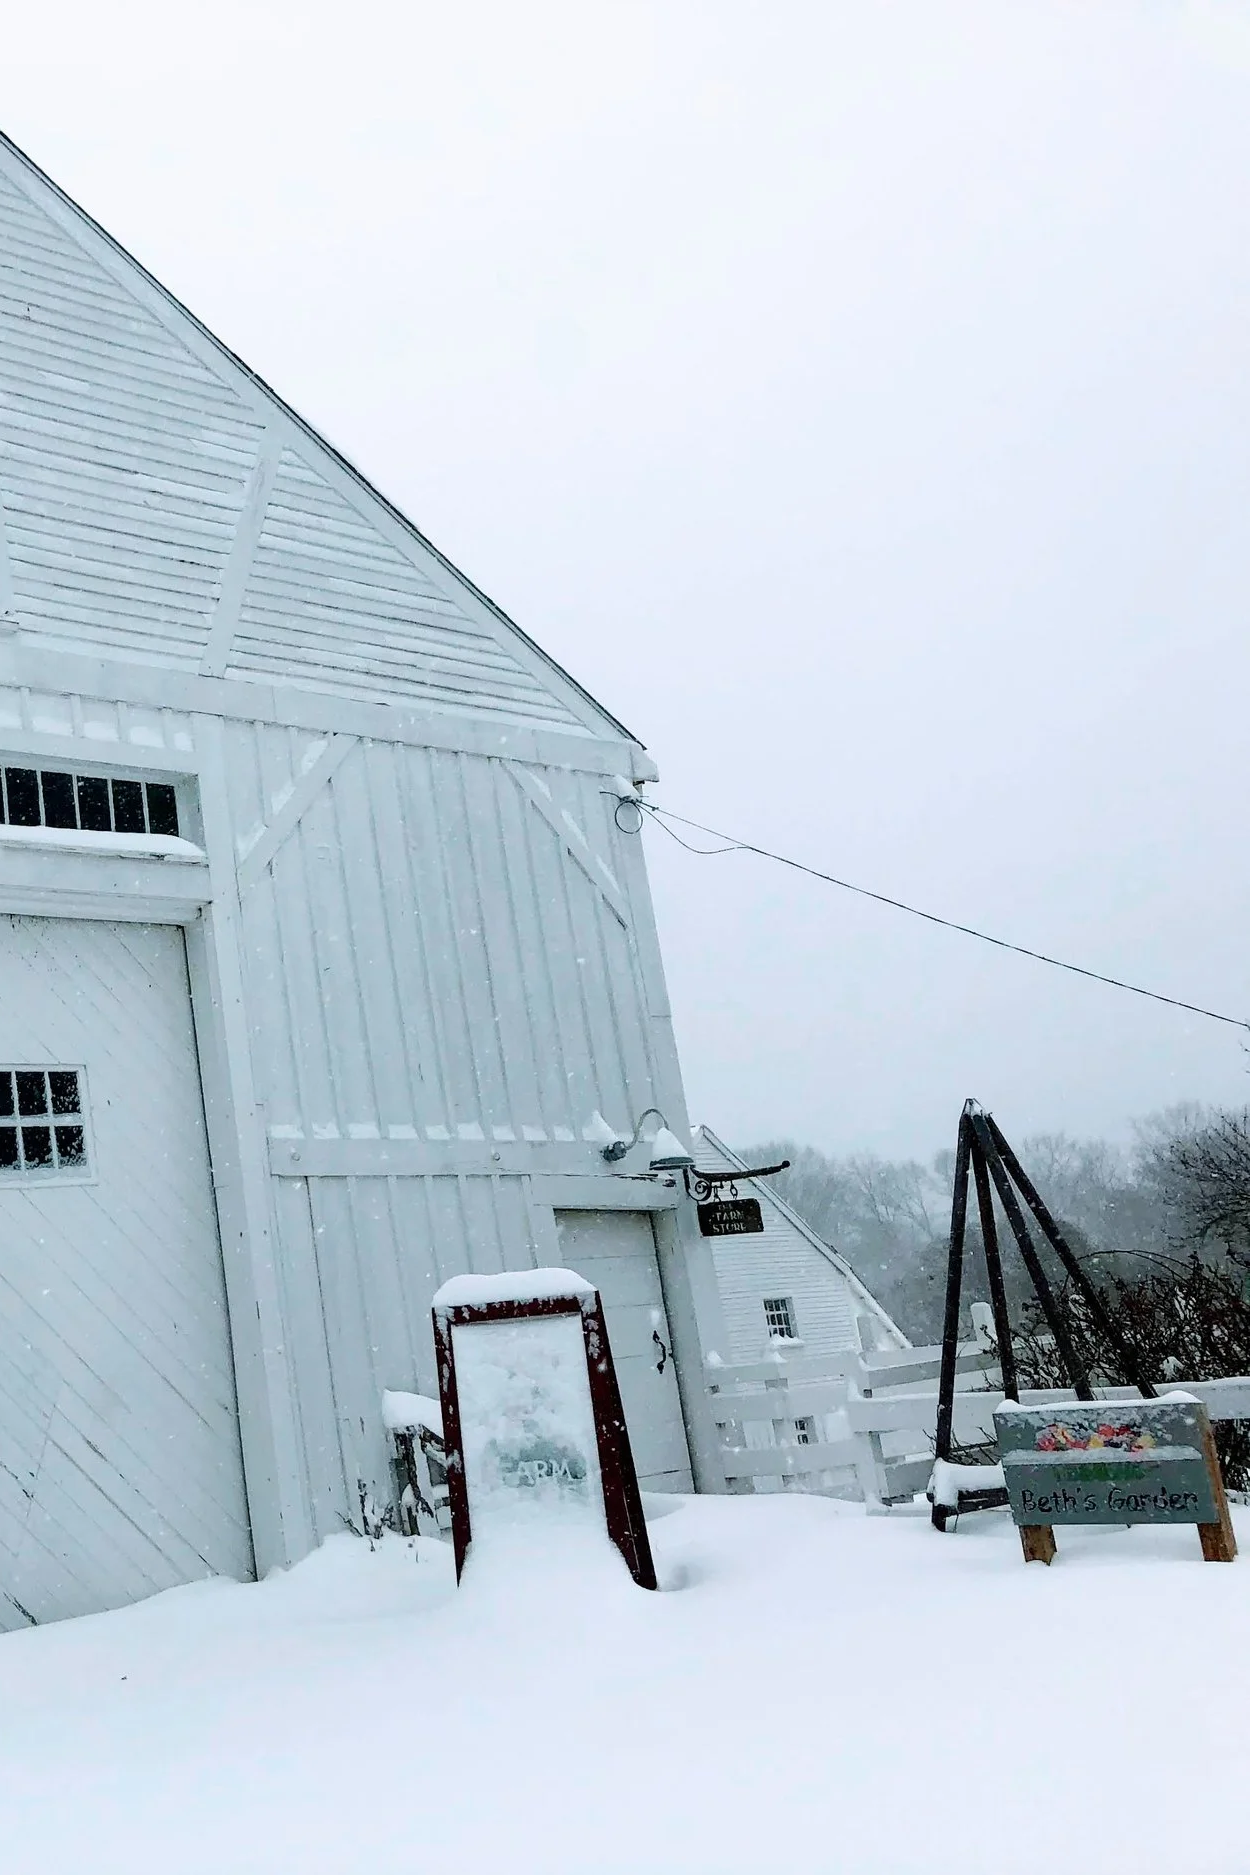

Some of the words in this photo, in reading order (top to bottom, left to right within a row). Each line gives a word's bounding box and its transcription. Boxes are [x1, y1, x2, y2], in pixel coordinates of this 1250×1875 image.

[712, 1222, 747, 1234] STORE
[1021, 1486, 1097, 1513] Beth's
[1108, 1486, 1199, 1513] Garden
